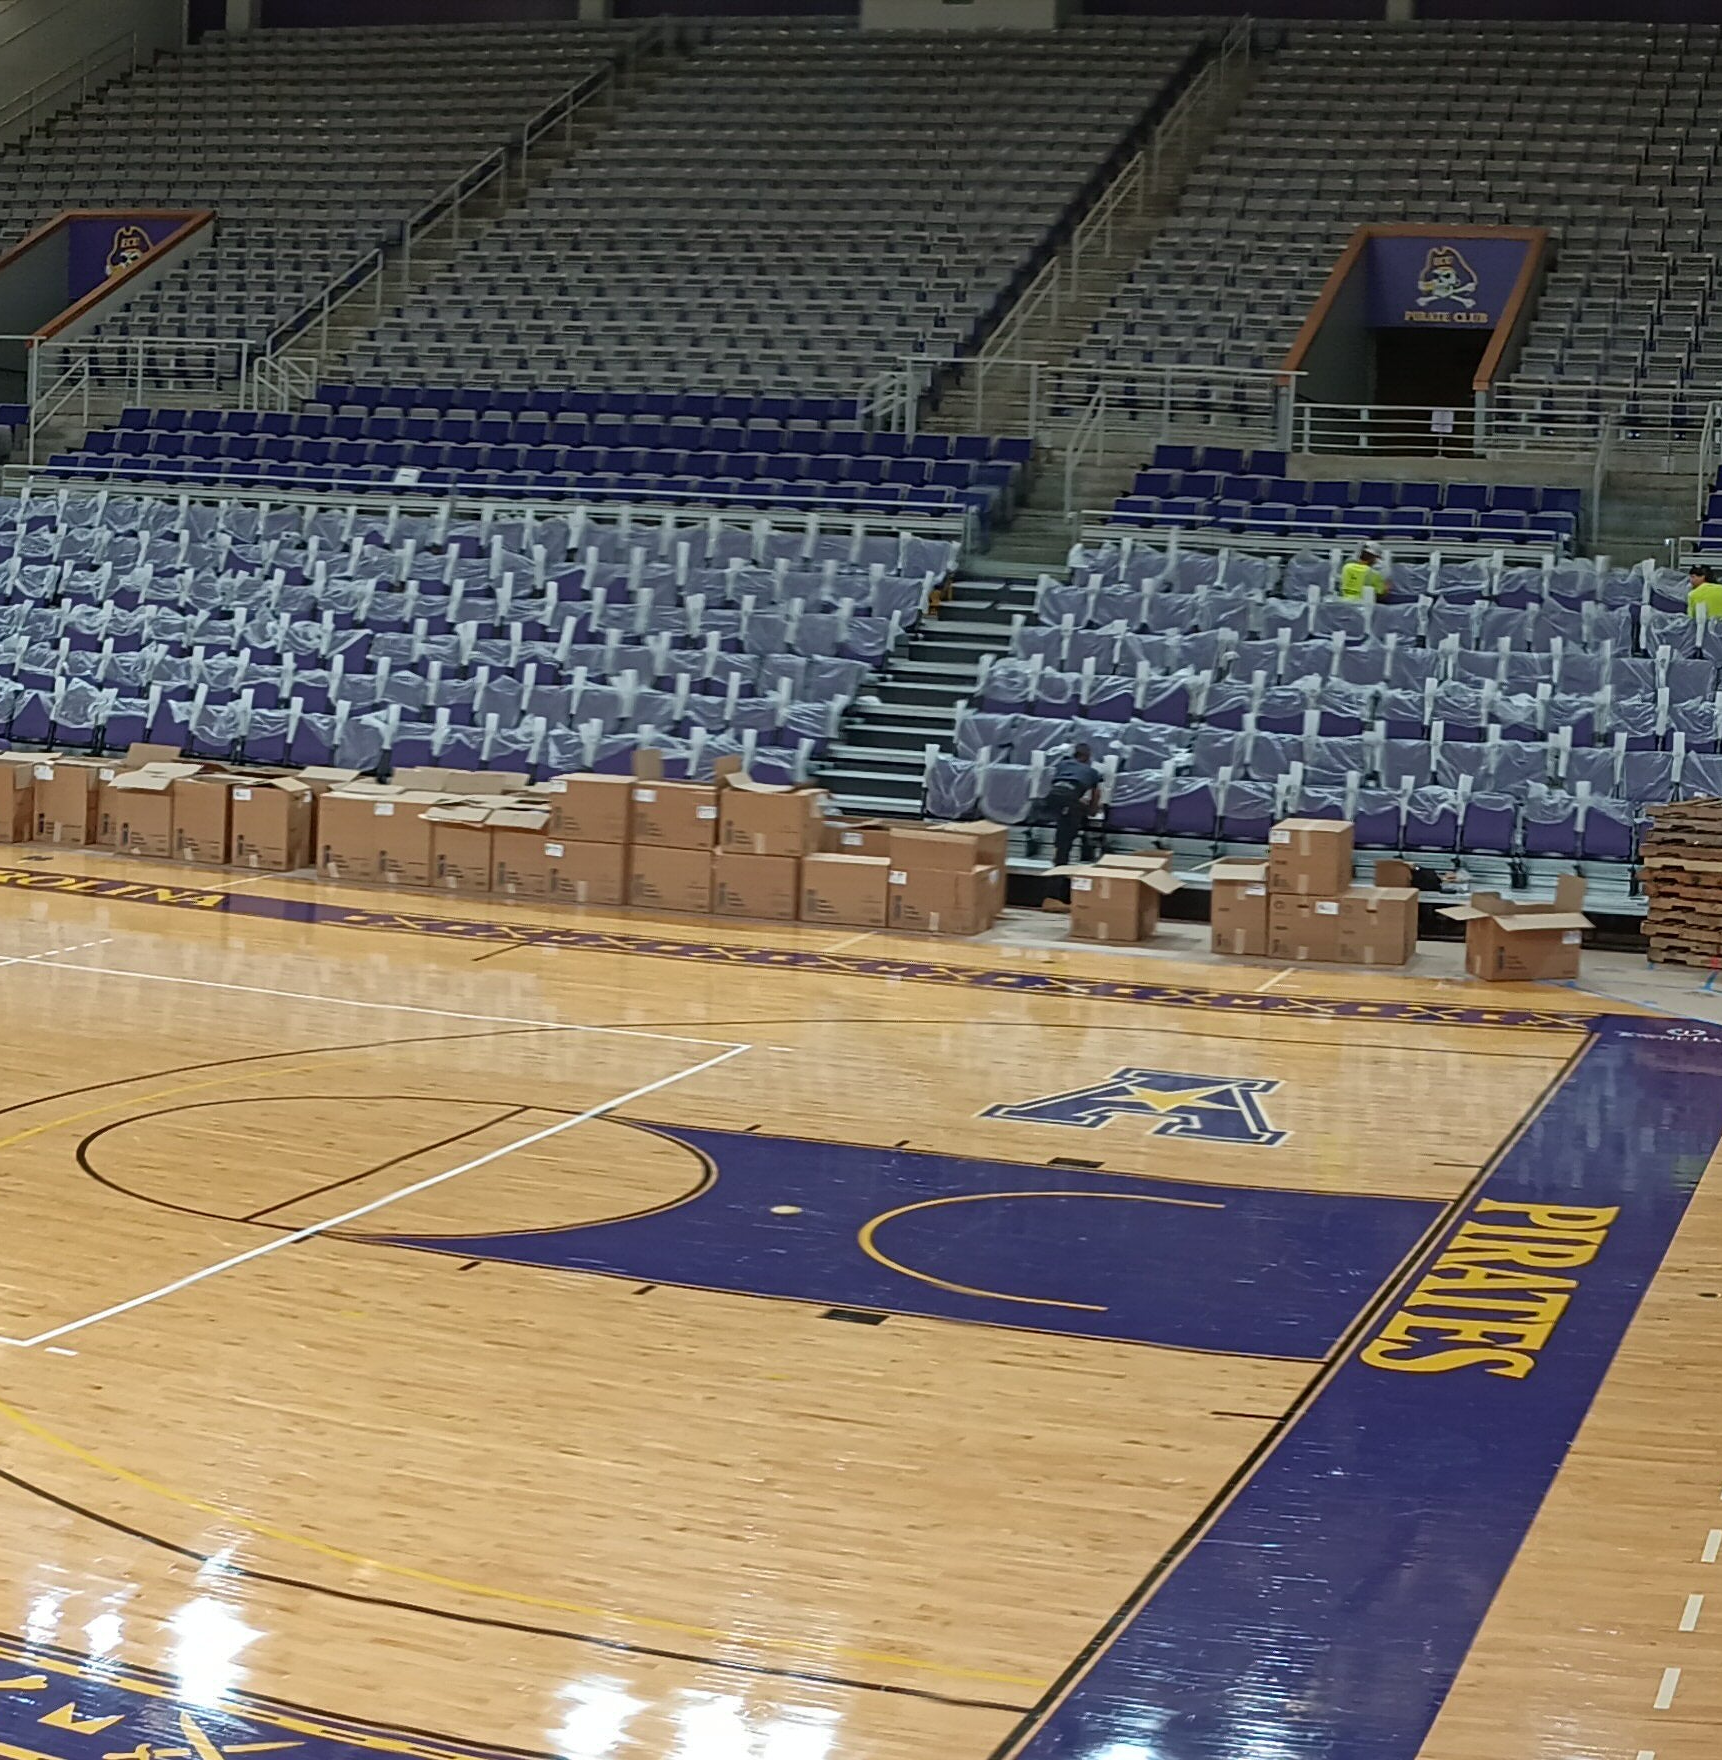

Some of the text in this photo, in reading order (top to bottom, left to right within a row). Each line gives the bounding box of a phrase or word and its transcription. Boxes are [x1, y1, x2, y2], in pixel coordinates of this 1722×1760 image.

[1404, 311, 1489, 323] PIRATE CLUB
[1359, 1197, 1621, 1379] PIRATES
